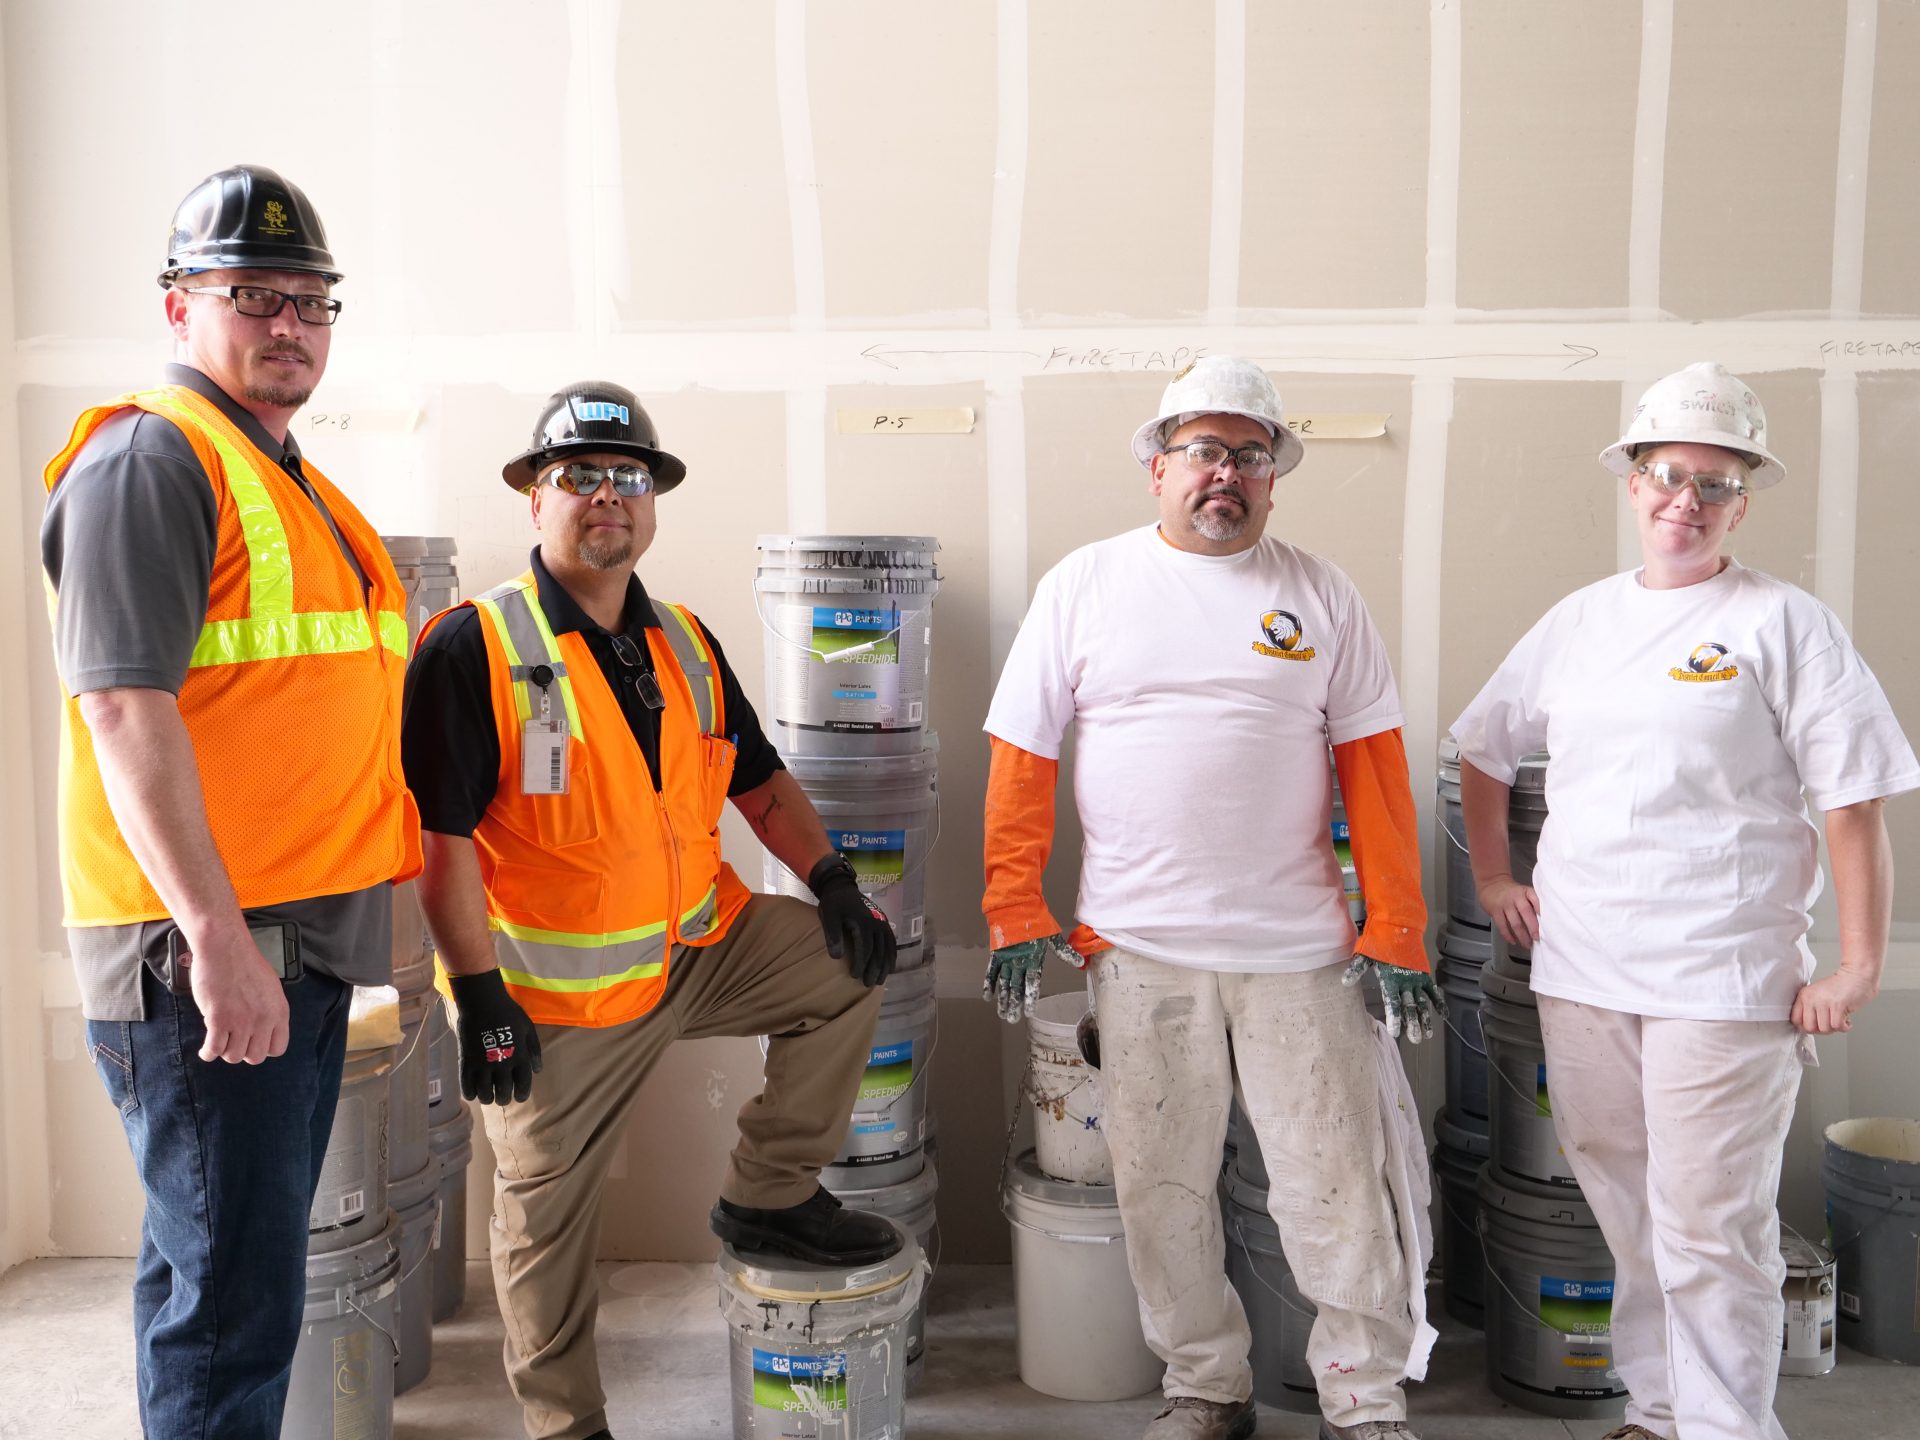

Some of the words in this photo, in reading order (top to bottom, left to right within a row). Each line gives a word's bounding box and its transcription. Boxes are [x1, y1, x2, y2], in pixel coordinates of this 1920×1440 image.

[577, 402, 629, 425] WPI
[835, 612, 853, 625] PPG
[855, 615, 882, 624] PAINTS
[842, 653, 897, 665] SPEEDHIDE
[842, 834, 859, 847] PPG
[862, 836, 888, 845] PAINTS
[873, 1049, 898, 1060] PAINTS
[1564, 1283, 1581, 1296] PPG
[1584, 1286, 1611, 1295] PAINTS
[773, 1358, 790, 1373] PPG
[792, 1360, 822, 1371] PAINTS
